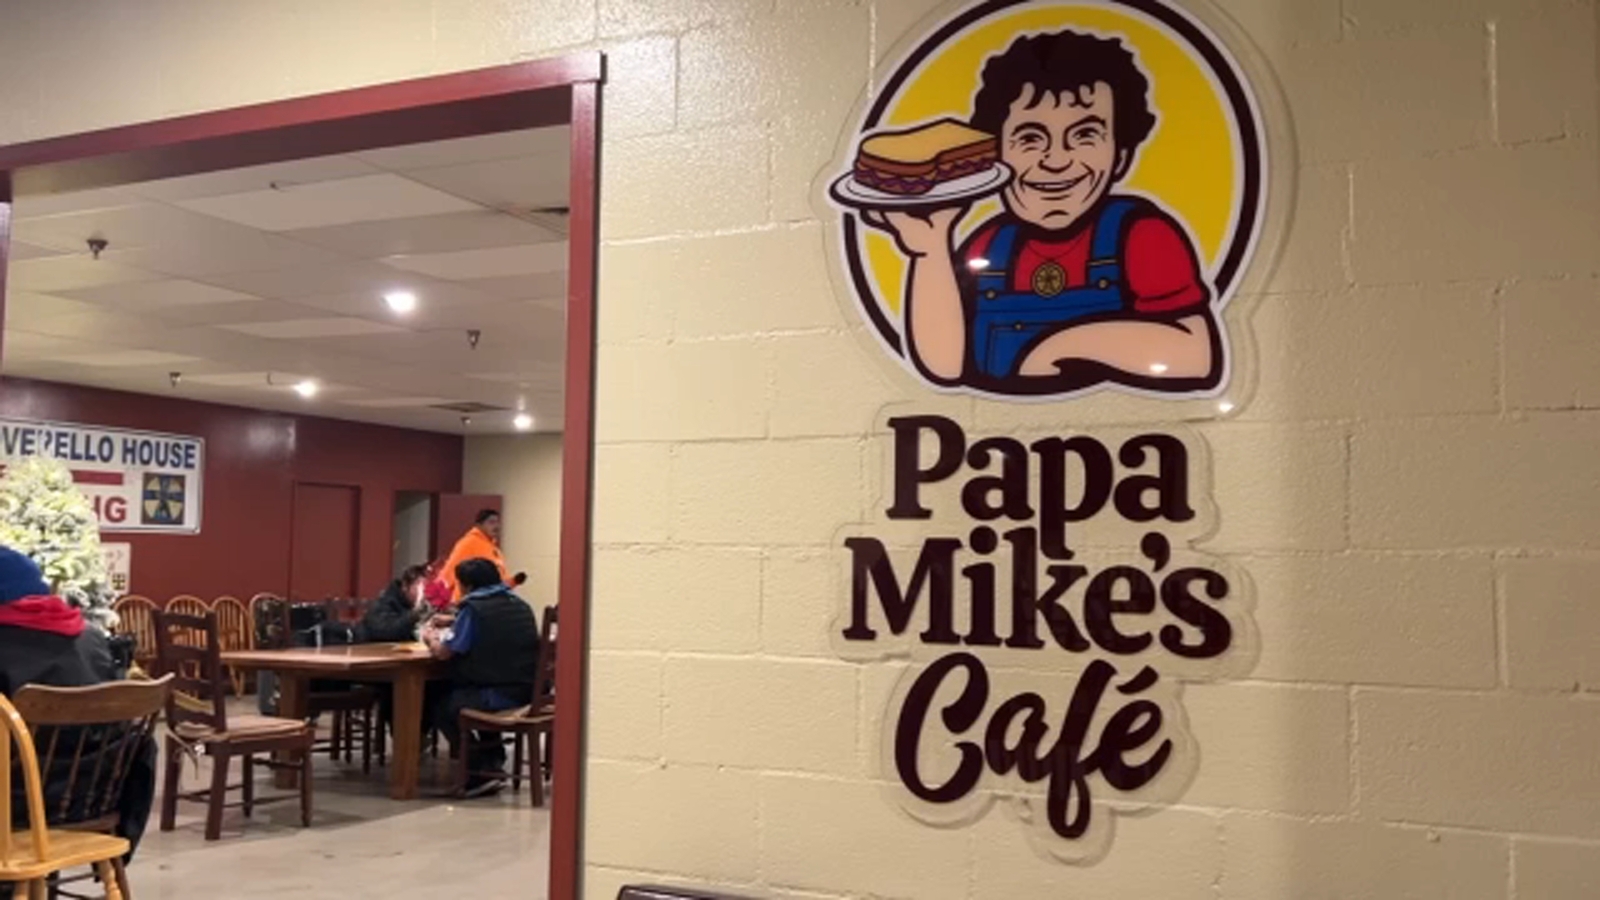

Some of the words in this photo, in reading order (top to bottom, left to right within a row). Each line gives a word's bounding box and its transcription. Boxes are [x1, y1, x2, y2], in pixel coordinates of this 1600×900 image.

[121, 437, 196, 469] HOUSE
[886, 415, 1195, 560] Papa
[842, 526, 1232, 659] Mike's
[894, 652, 1173, 839] Café
